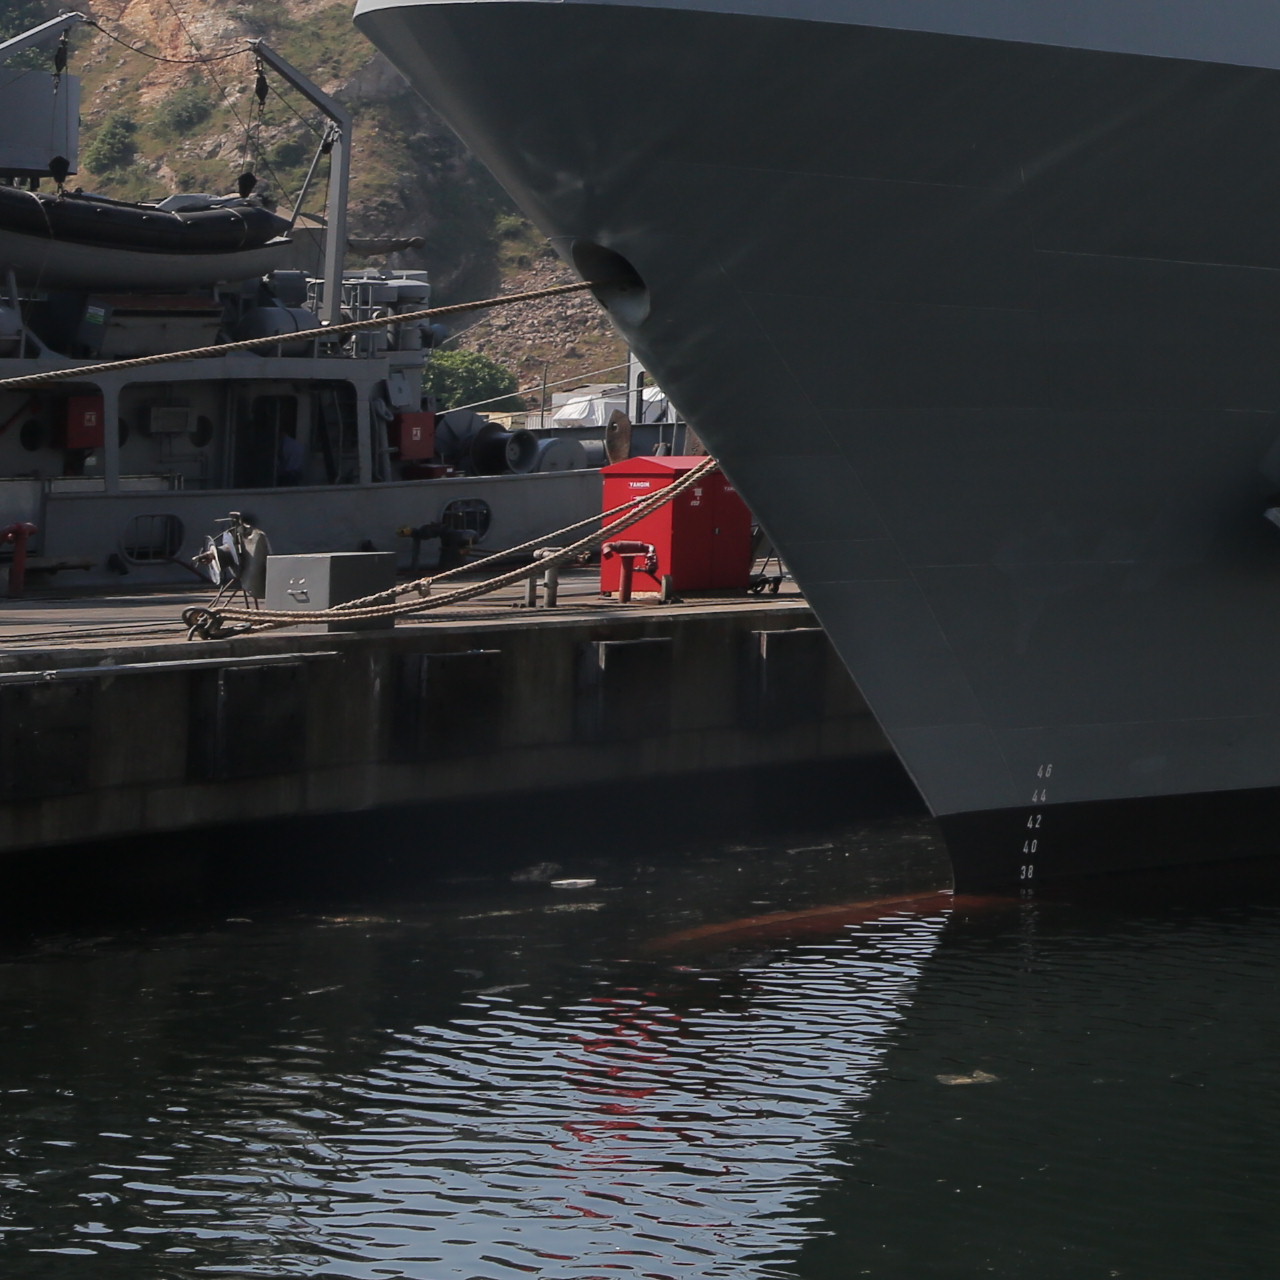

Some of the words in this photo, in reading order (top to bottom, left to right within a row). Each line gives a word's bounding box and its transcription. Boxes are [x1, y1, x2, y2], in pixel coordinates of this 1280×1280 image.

[1037, 763, 1052, 778] 46
[1032, 789, 1046, 803] 44
[1027, 814, 1042, 829] 42
[1023, 839, 1038, 854] 40
[1020, 864, 1034, 879] 38
